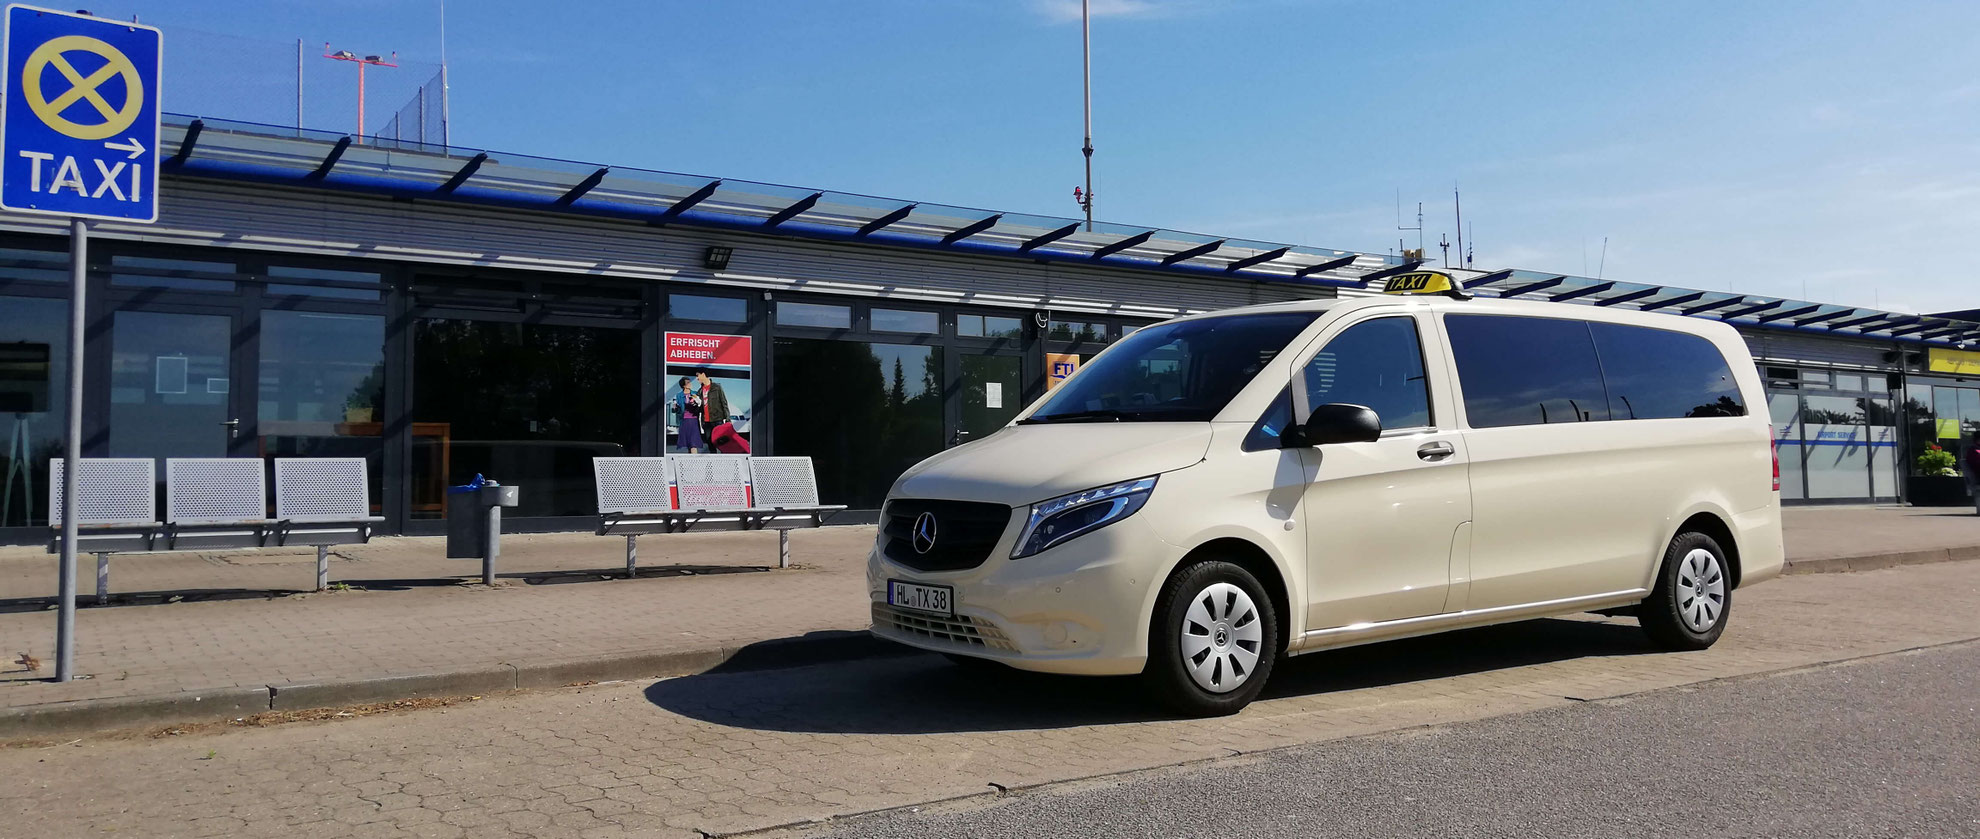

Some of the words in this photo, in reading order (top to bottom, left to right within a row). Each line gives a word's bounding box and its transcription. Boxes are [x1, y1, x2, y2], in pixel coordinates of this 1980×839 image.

[19, 150, 141, 202] TAXI
[1390, 276, 1427, 290] TAXI
[670, 337, 720, 348] ERFRISCHT
[670, 349, 716, 360] ABHEBEN.
[1054, 362, 1074, 375] FTI
[896, 584, 910, 605] HL
[915, 587, 930, 609] TX
[932, 590, 947, 610] 38
